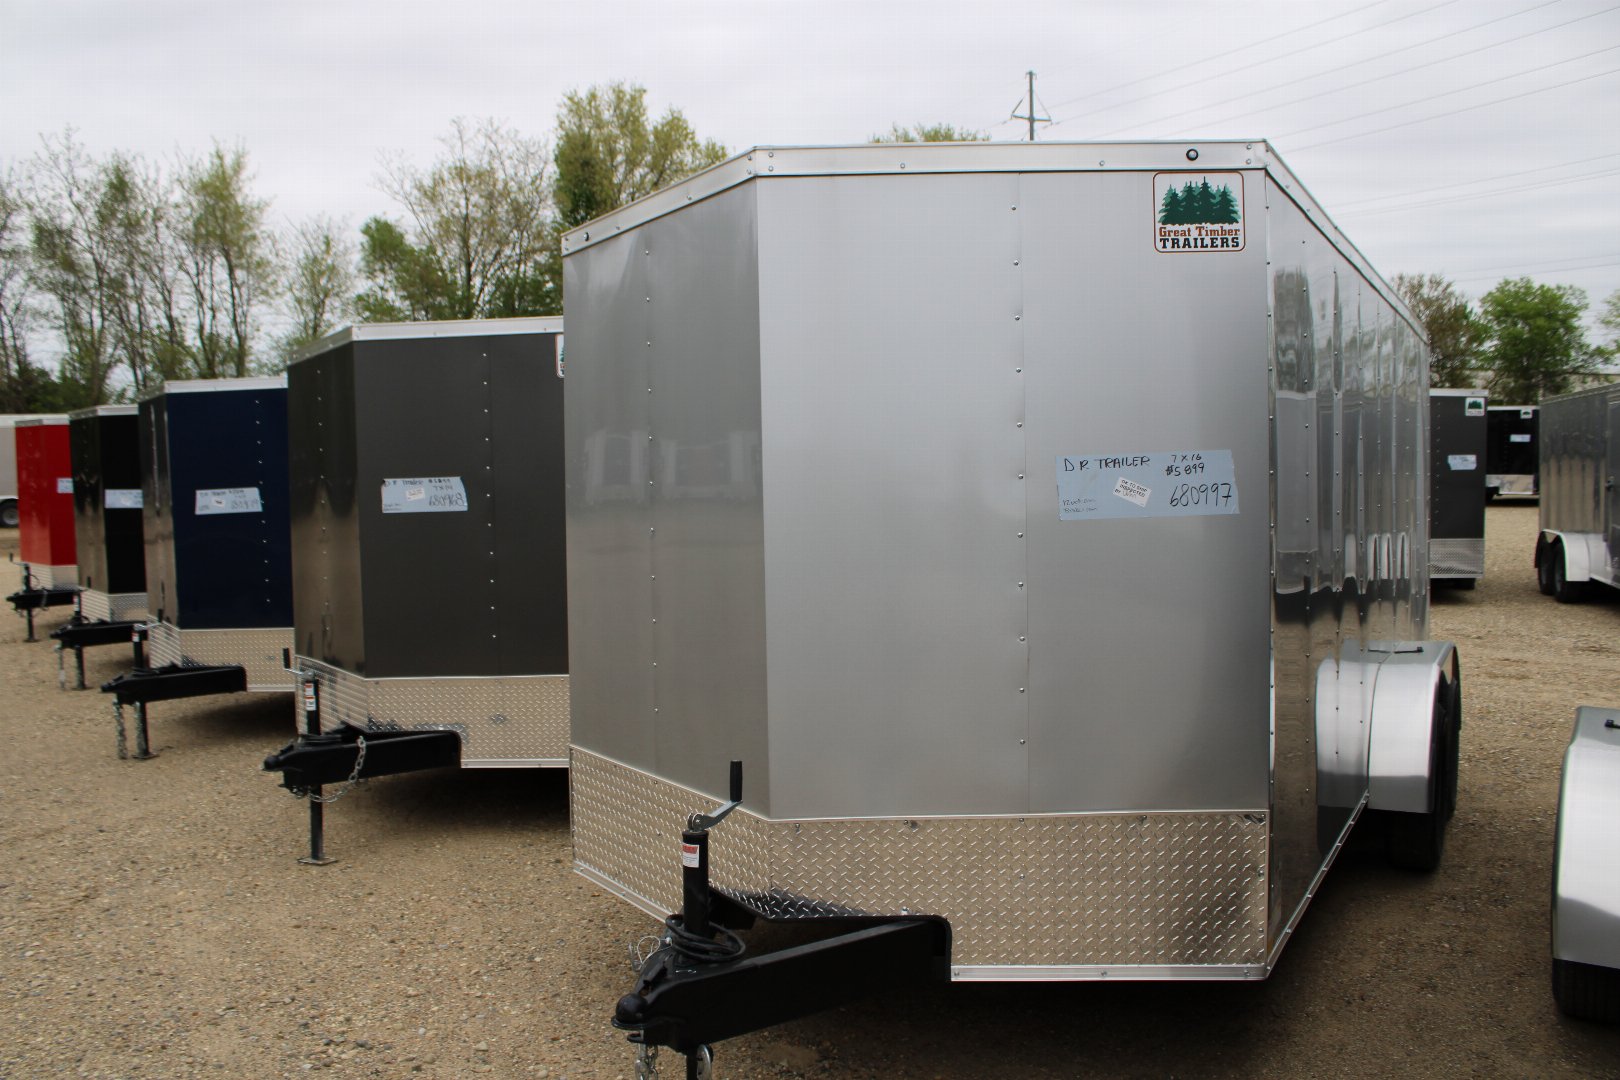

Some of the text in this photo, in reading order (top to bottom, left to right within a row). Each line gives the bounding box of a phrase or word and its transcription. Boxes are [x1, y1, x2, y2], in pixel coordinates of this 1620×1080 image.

[1159, 225, 1240, 237] Great Timber
[1159, 237, 1240, 249] TRAILERS
[1094, 455, 1151, 470] TRAILER
[1169, 482, 1233, 508] 680997
